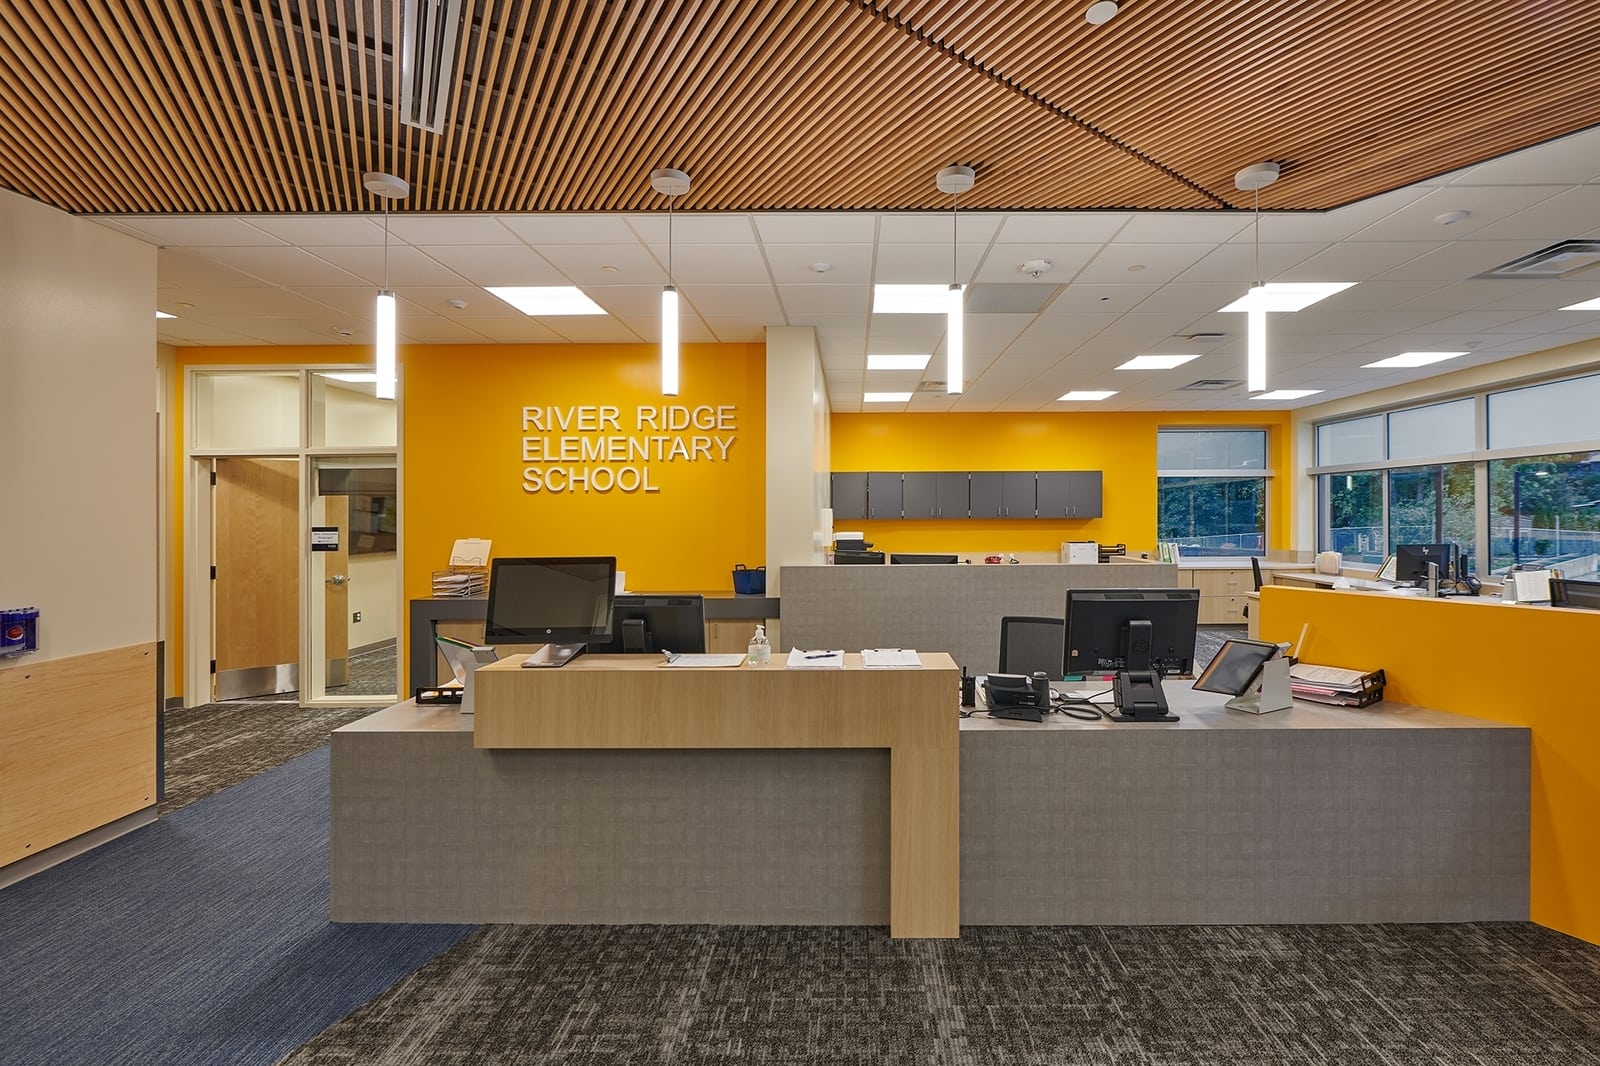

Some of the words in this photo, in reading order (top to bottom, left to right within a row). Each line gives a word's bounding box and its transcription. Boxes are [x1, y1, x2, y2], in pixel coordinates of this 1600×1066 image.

[522, 405, 621, 431] RIVER
[637, 405, 737, 430] RIDGE
[522, 436, 736, 462] ELEMENTARY
[522, 466, 660, 493] SCHOOL
